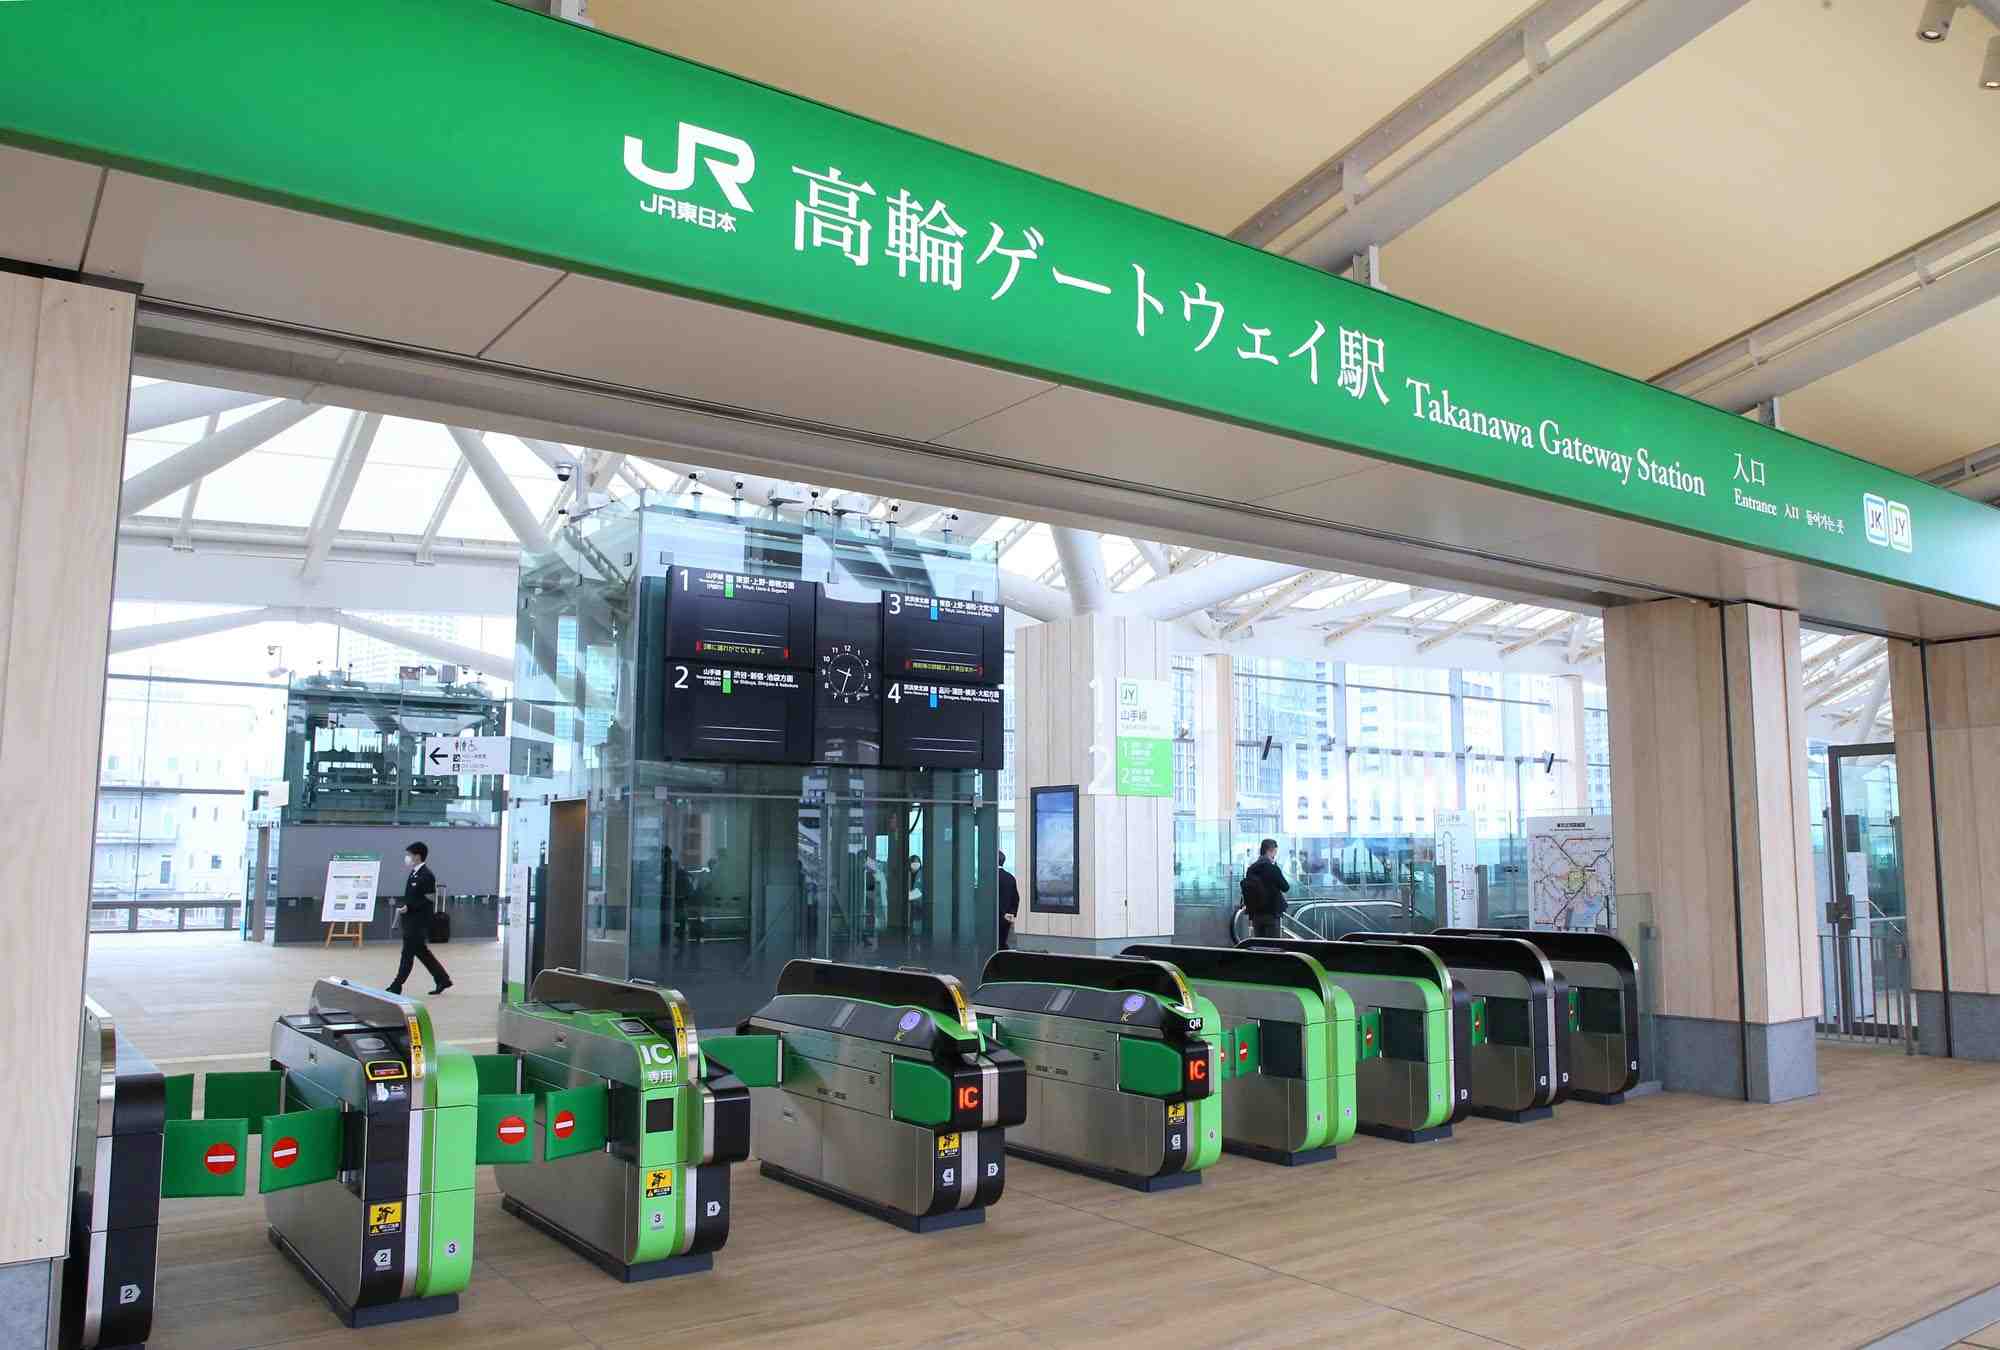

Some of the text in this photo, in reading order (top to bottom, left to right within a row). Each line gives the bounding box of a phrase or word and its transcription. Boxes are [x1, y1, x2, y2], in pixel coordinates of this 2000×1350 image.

[623, 121, 756, 213] JR
[639, 194, 737, 233] JR東日本
[791, 164, 1390, 406] 高輪ゲートウェイ駅
[1406, 377, 1706, 497] Takanawa Gateway Station
[1733, 452, 1766, 487] 入口
[1734, 487, 1777, 517] Entrance
[1869, 511, 1906, 537] JK JY
[679, 568, 689, 592] 1
[888, 593, 901, 614] 3
[674, 665, 689, 689] 2
[887, 682, 902, 704] 4
[1124, 687, 1136, 701] JY
[1120, 710, 1148, 722] 山手線
[1121, 767, 1130, 784] 2
[1189, 1018, 1202, 1030] QR
[639, 1043, 673, 1065] IC
[1190, 1060, 1206, 1081] IC
[959, 1086, 978, 1109] IC
[380, 1252, 388, 1263] 2
[448, 1243, 456, 1254] 3
[124, 1288, 133, 1300] 2
